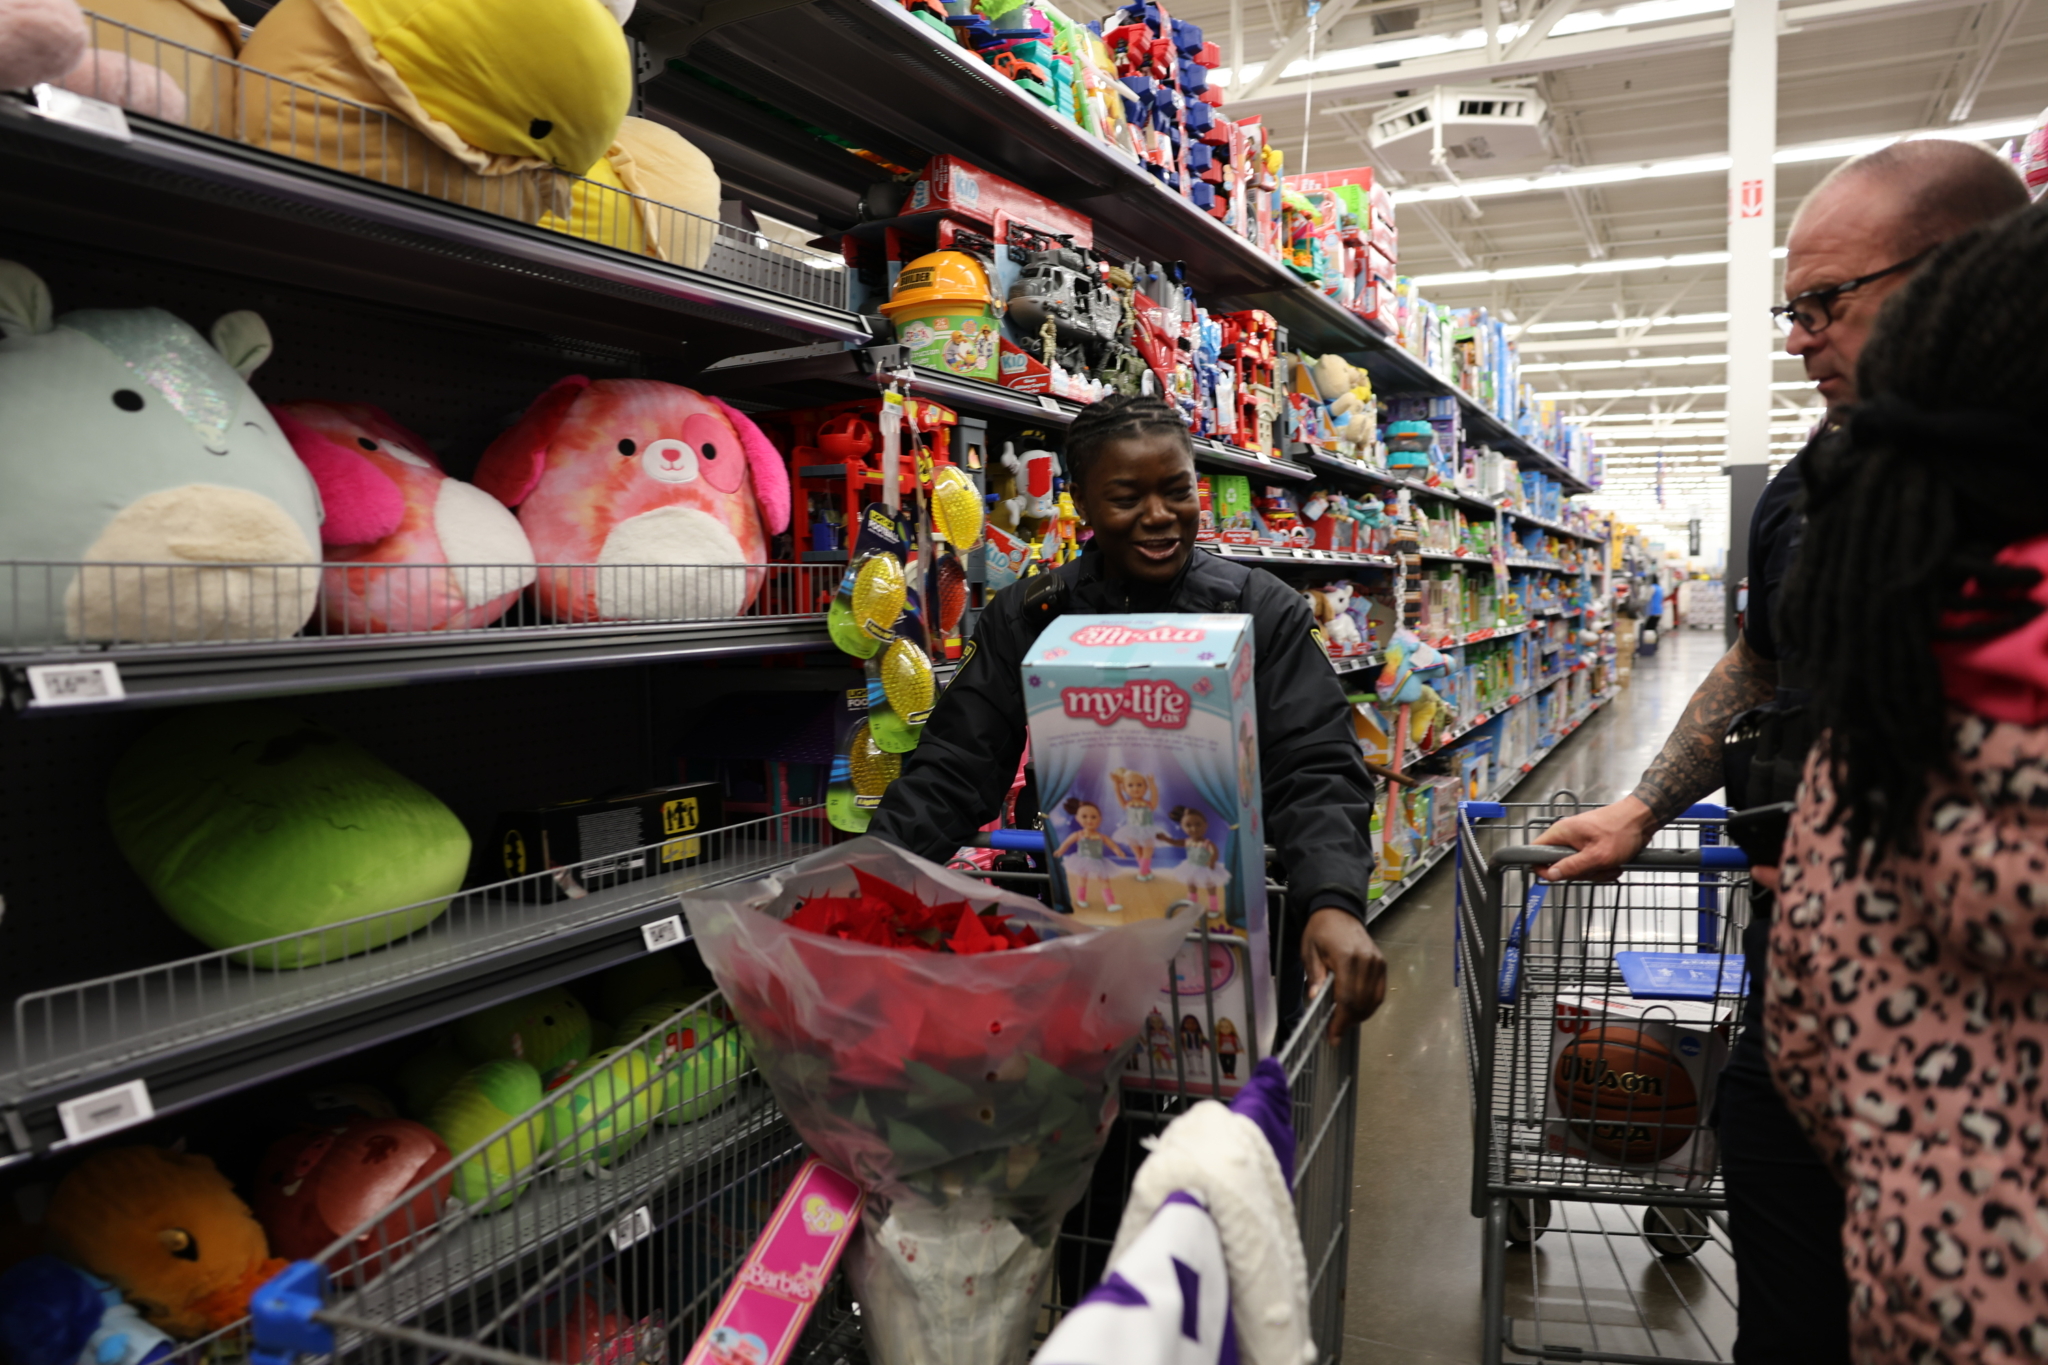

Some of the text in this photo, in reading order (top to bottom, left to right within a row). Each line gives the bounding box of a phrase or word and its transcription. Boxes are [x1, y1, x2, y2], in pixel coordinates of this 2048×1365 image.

[955, 173, 978, 201] KID
[901, 271, 930, 287] BUILDER
[1002, 355, 1025, 369] KID
[1162, 713, 1181, 724] as
[1561, 1054, 1664, 1096] Wilson
[739, 1261, 811, 1299] Barbie
